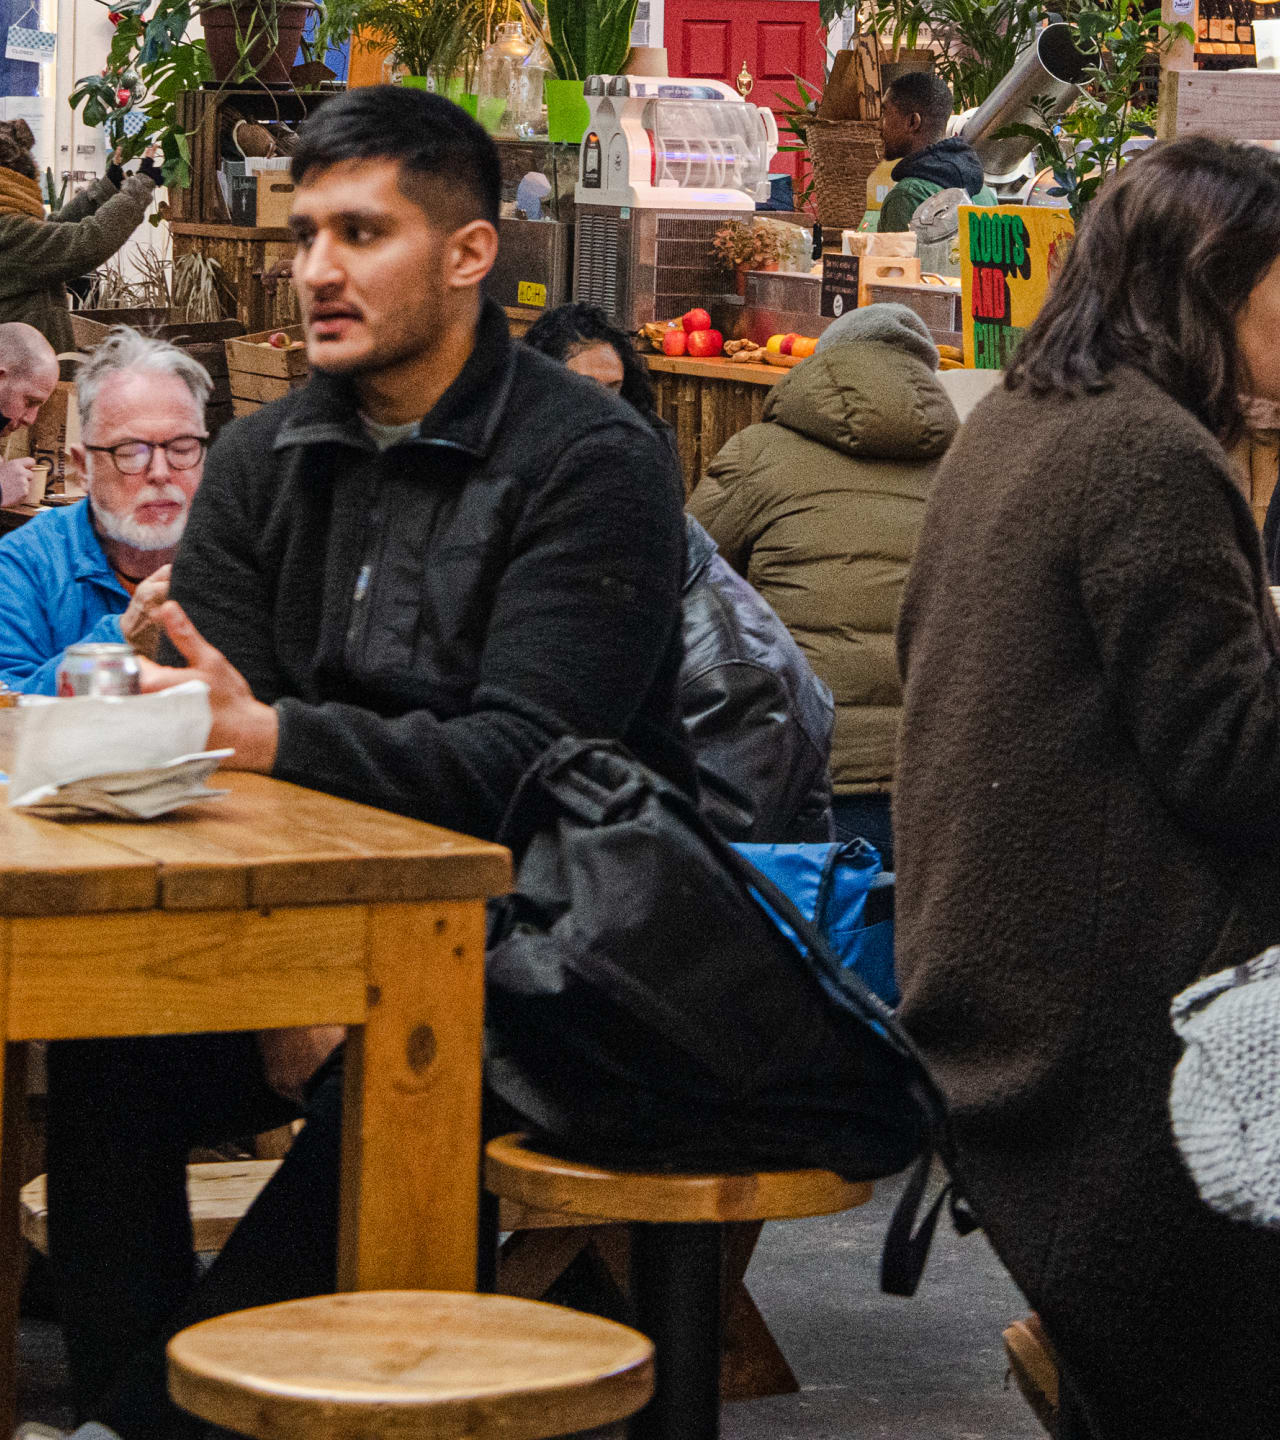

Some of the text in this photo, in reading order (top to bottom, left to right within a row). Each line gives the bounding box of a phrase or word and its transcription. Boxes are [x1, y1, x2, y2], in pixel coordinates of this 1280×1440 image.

[968, 211, 1027, 266] ROOTS
[971, 266, 1006, 320] AND
[973, 320, 1024, 370] CULT
